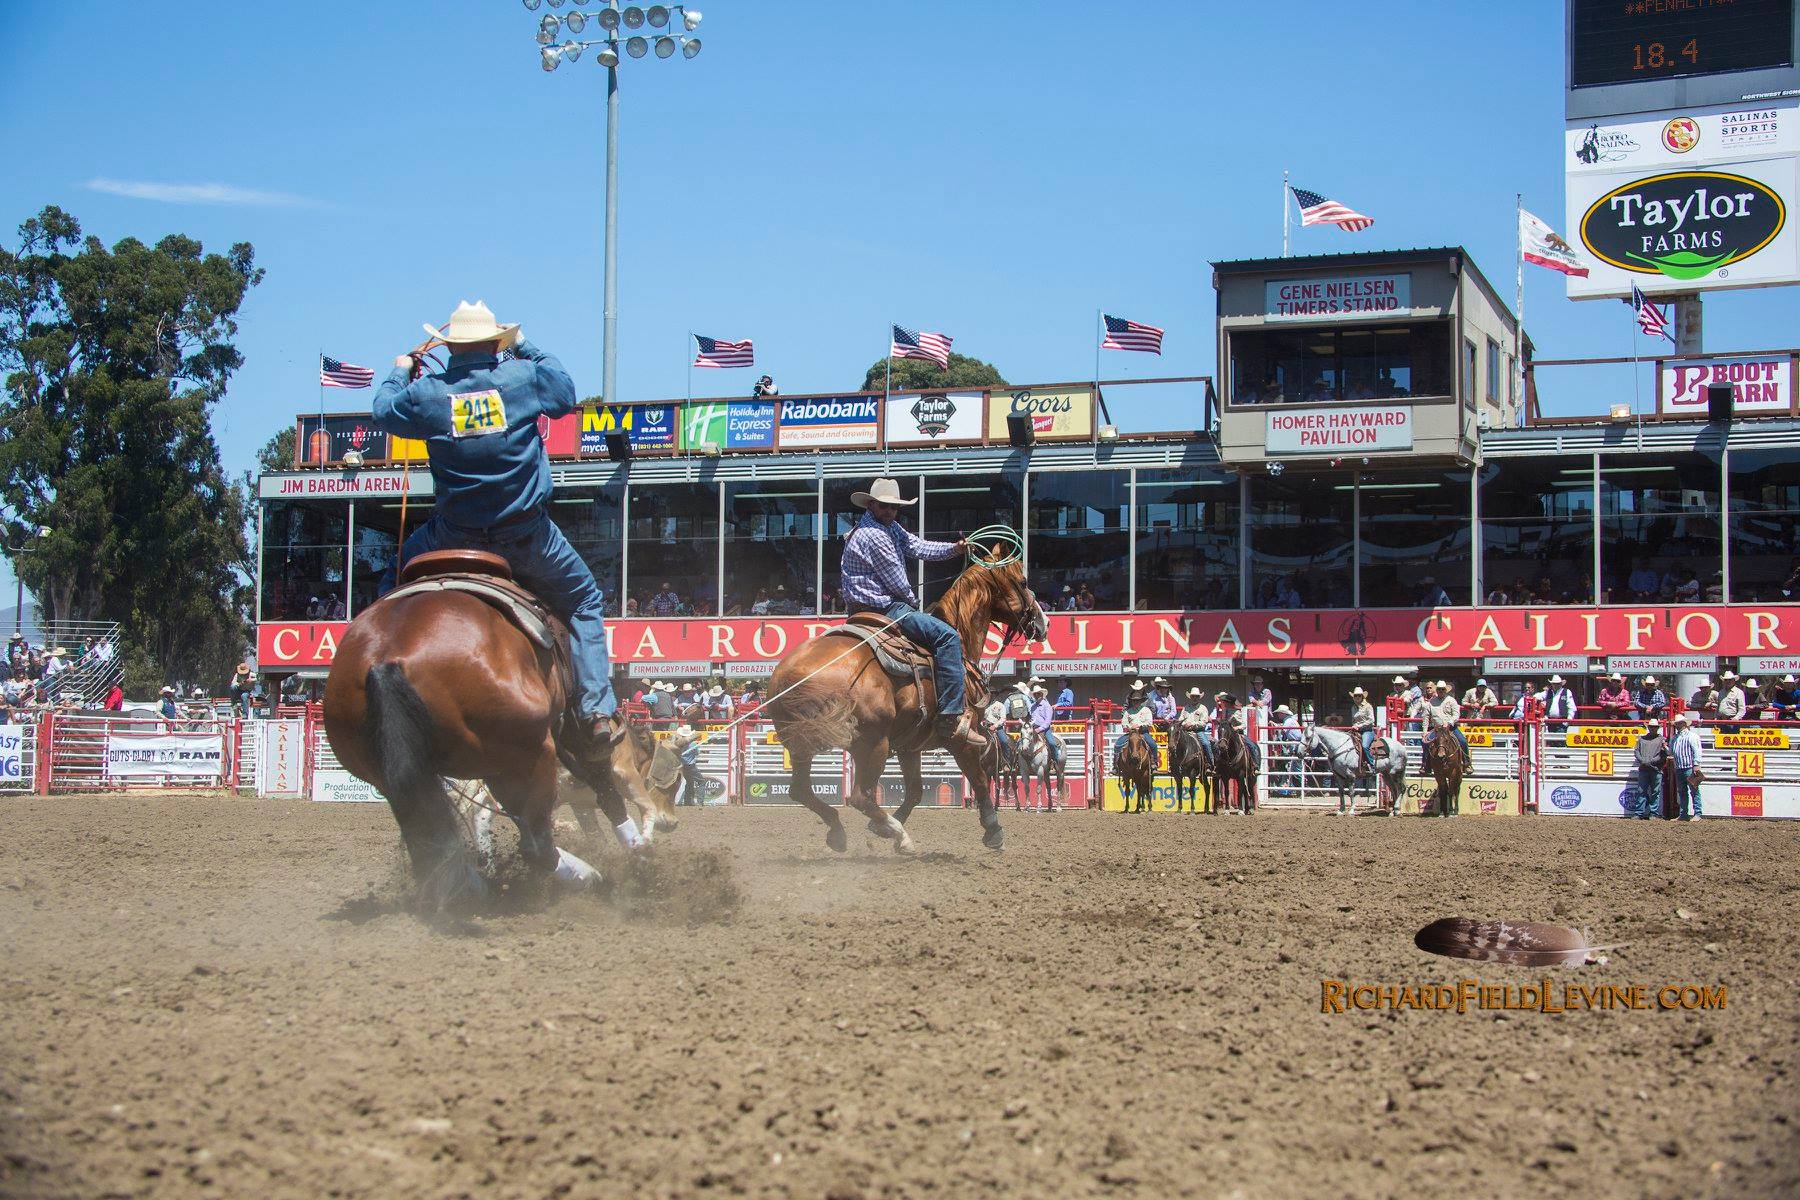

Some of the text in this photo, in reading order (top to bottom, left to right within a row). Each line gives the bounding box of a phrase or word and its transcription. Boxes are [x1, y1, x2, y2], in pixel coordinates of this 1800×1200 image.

[1632, 38, 1698, 70] 18.4
[1722, 111, 1777, 123] SALINAS
[1722, 123, 1777, 135] SPORTS
[1611, 188, 1755, 234] Taylor
[1642, 230, 1723, 253] FARMS
[1280, 279, 1395, 300] GENE NIELSEN
[1277, 296, 1398, 317] TIMERS STAND
[1712, 362, 1779, 383] BOOT
[1733, 382, 1778, 403] ARN
[780, 397, 878, 419] Rabobank
[919, 399, 949, 413] Taylor
[1010, 391, 1072, 414] Coors
[463, 398, 494, 429] 241
[730, 406, 774, 418] Holiday Inn
[918, 412, 948, 422] Farms
[729, 418, 772, 433] Express
[1272, 412, 1406, 430] HOMER HAYWARD
[581, 433, 600, 443] Jeep
[734, 432, 764, 441] & Suites
[801, 431, 824, 439] Sound
[825, 430, 840, 438] and
[1300, 428, 1377, 446] PAVILION
[280, 476, 411, 494] JIM BARDIN ARENA
[1416, 611, 1789, 653] CALIFOR
[633, 665, 659, 674] FIRMIN
[681, 665, 707, 673] FAMILY
[730, 665, 766, 673] PEDRAZZI
[1035, 663, 1118, 671] GENE NIELSEN FAMILY
[1204, 662, 1231, 670] HANSEN
[1494, 660, 1579, 669] JEFFERSON FARMS
[1612, 660, 1712, 669] SAM EASTMAN FAMILY
[1759, 661, 1786, 670] STAR
[1573, 735, 1629, 745] SALINAS
[1723, 736, 1782, 746] SALINAS
[179, 751, 220, 760] RAM
[277, 722, 289, 791] SALINAS
[1591, 752, 1611, 773] 15
[1741, 754, 1761, 774] 14
[324, 782, 370, 791] Production
[1469, 784, 1508, 800] Coors
[333, 791, 369, 800] Services
